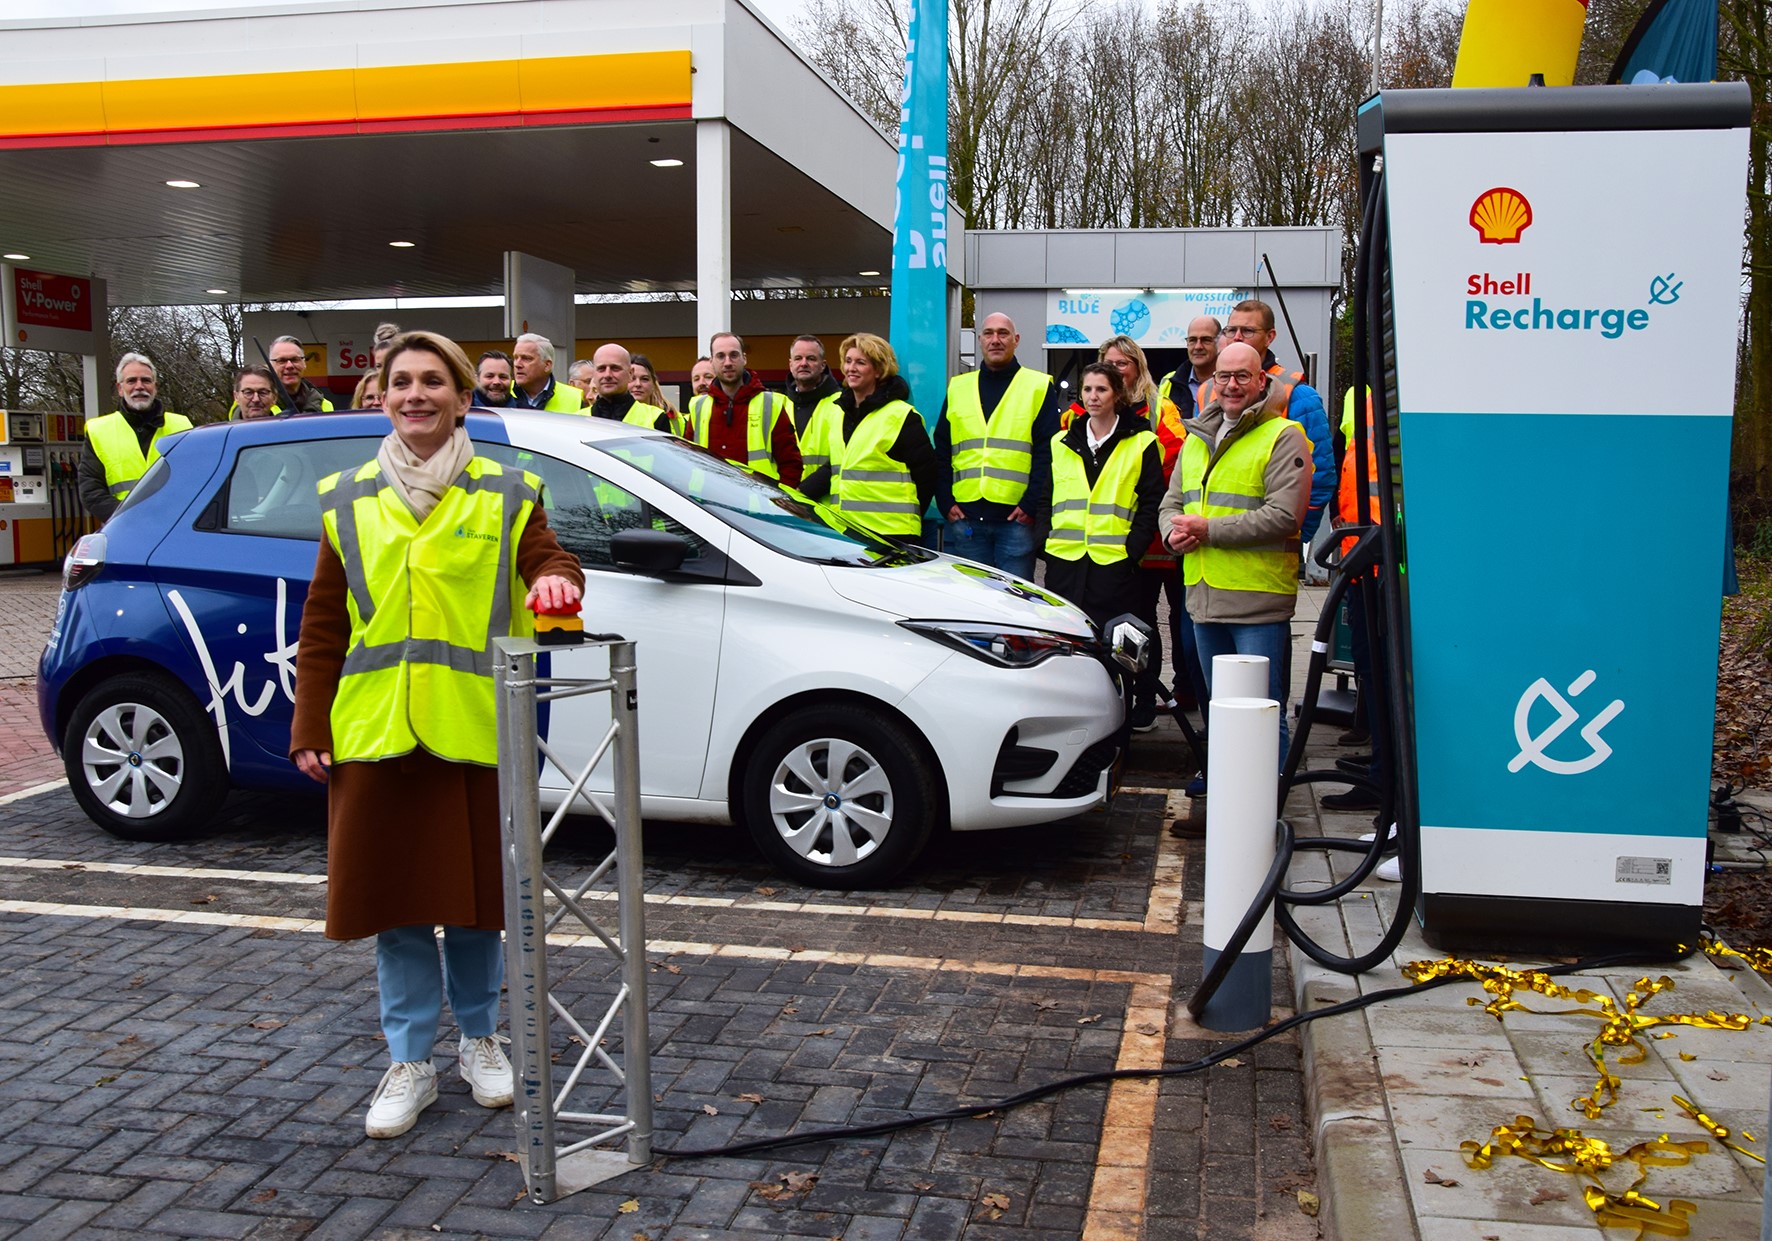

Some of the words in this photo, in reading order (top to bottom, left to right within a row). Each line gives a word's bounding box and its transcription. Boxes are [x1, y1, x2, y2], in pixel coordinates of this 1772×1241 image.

[20, 277, 42, 291] Shell
[1467, 272, 1531, 295] Shell
[21, 290, 78, 312] V-Power
[1184, 291, 1249, 302] wasstraat
[1058, 299, 1099, 314] BLUE
[1203, 303, 1232, 315] inrit
[1465, 297, 1649, 339] Recharge
[340, 346, 375, 369] Sel
[466, 532, 499, 542] STAVEREN
